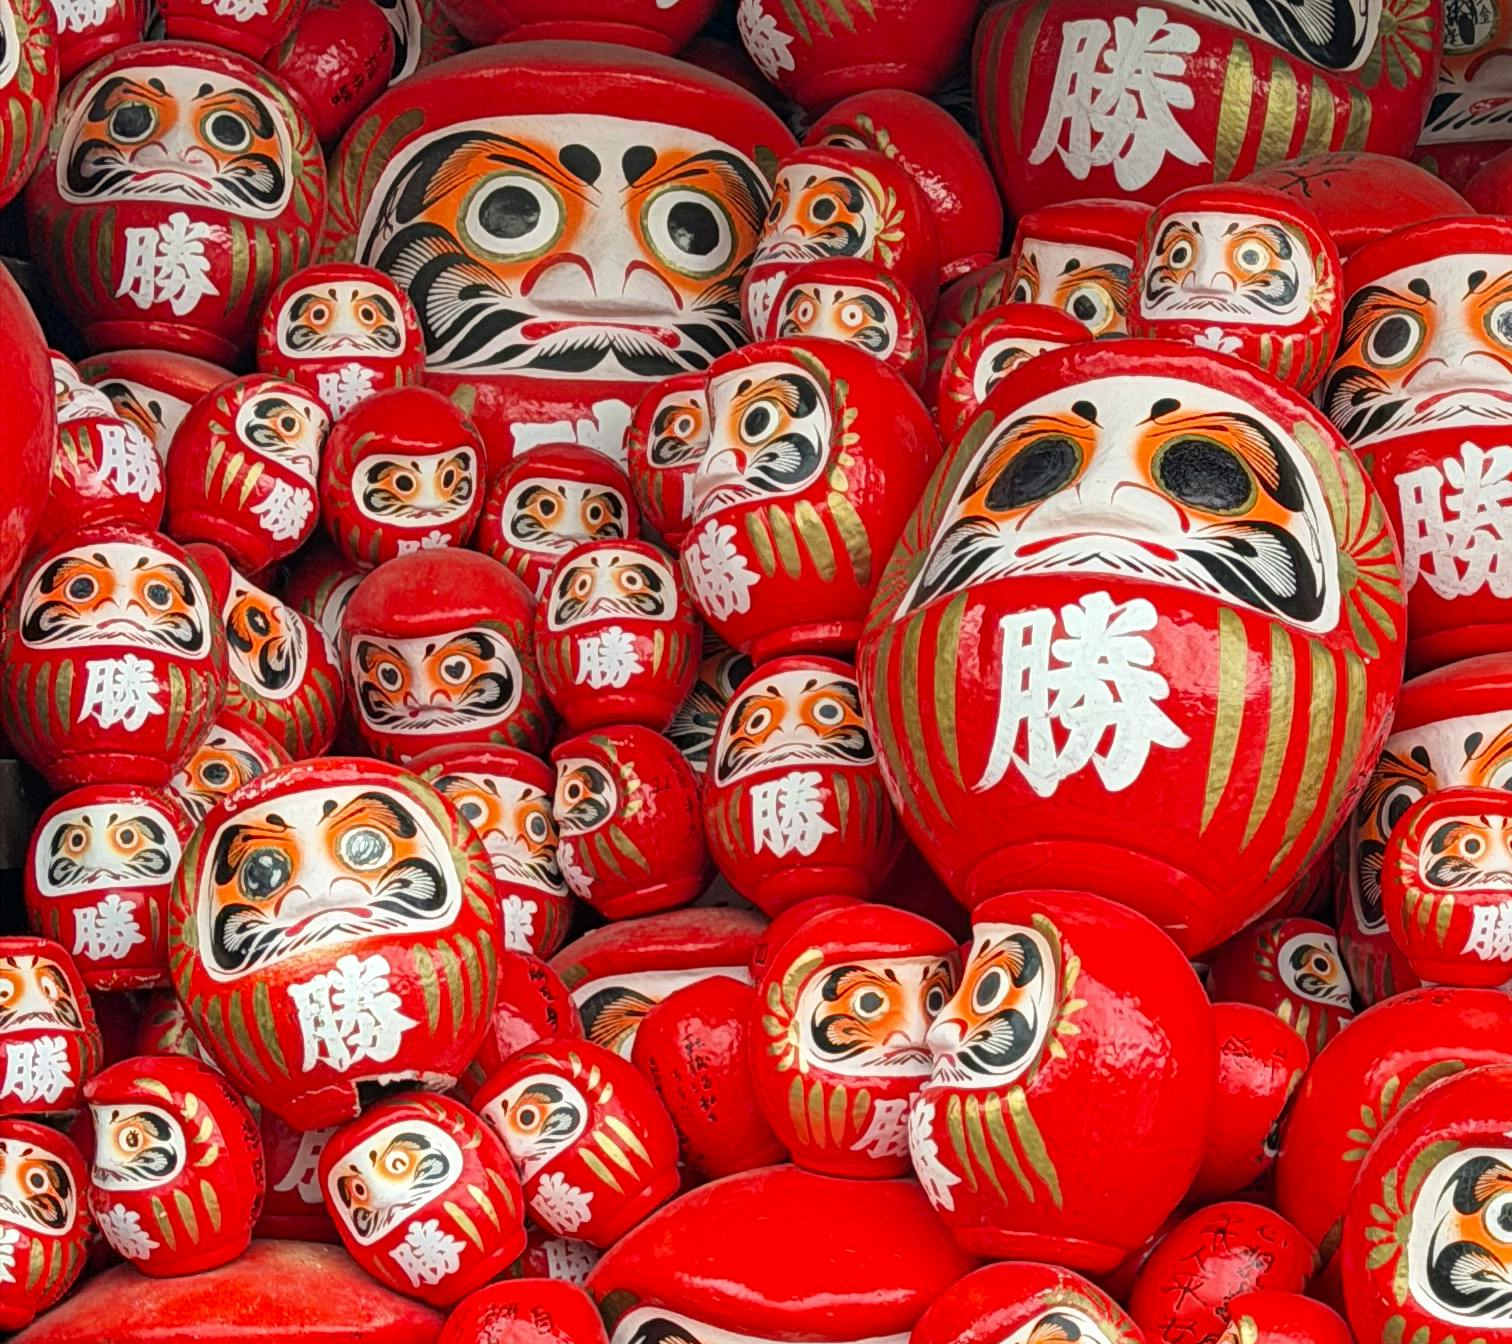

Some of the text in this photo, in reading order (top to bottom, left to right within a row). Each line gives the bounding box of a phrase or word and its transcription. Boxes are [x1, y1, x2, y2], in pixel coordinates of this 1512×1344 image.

[1029, 6, 1208, 191] 勝
[117, 211, 222, 316] 勝
[317, 362, 377, 422] 勝
[97, 422, 162, 503] 勝
[250, 476, 315, 541] 勝
[685, 519, 760, 620] 勝
[79, 653, 164, 732] 勝
[575, 626, 644, 689] 勝
[973, 591, 1189, 798] 勝
[749, 771, 835, 857] 勝
[73, 893, 145, 961] 勝
[287, 953, 418, 1072] 勝
[0, 1035, 73, 1103] 勝
[530, 1171, 594, 1234] 勝
[389, 1218, 466, 1288] 勝
